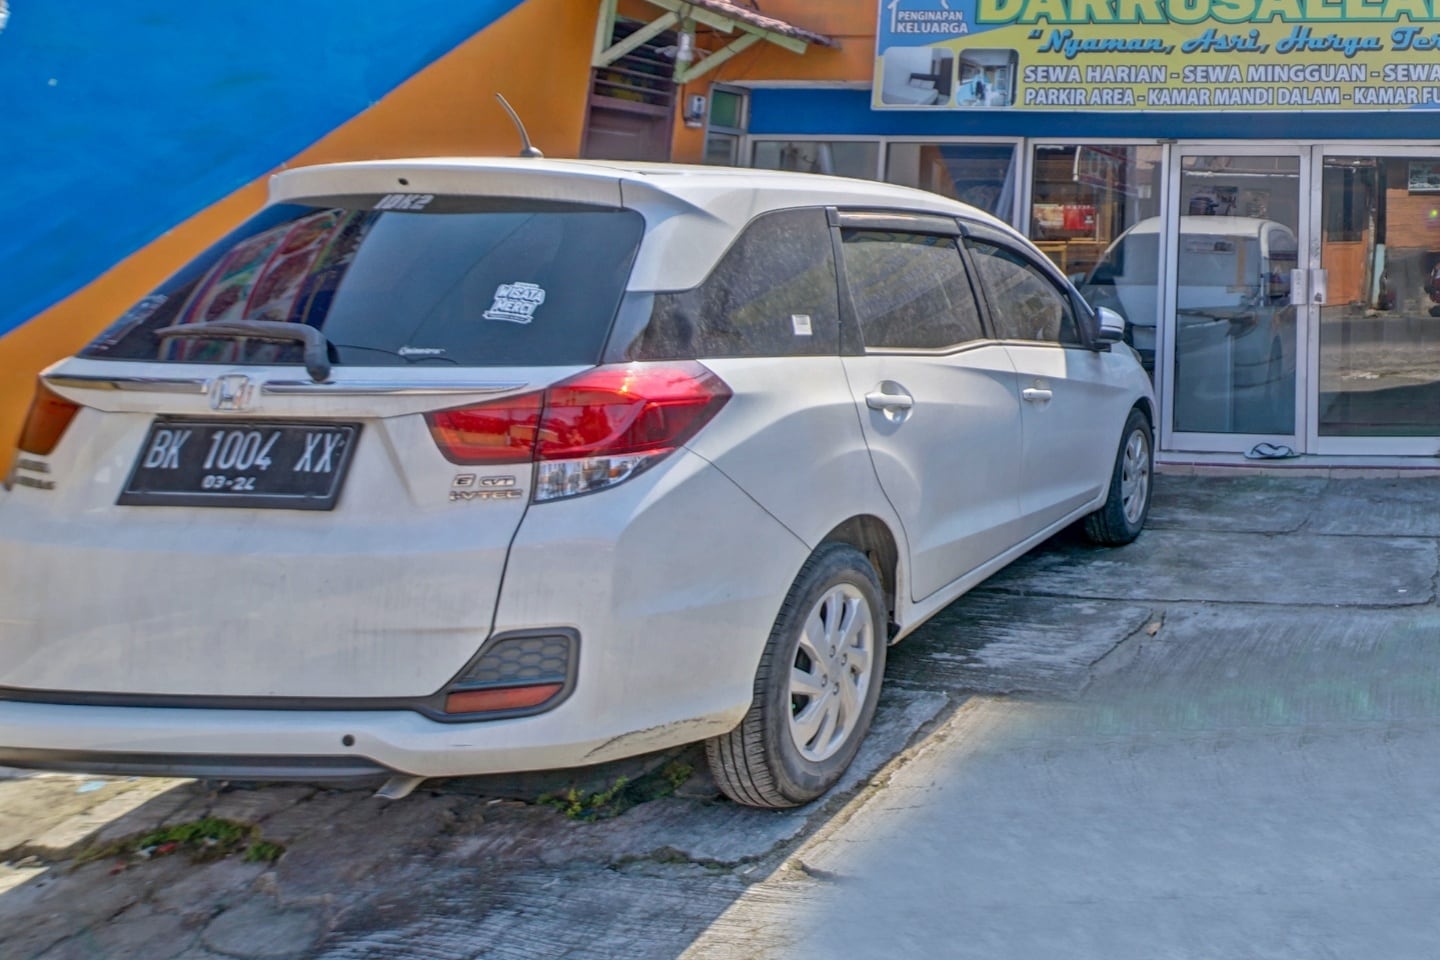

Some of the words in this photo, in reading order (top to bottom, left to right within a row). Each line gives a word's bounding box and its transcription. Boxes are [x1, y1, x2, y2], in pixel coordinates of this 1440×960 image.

[898, 10, 963, 21] PENGINAPAN
[896, 21, 968, 34] KELUARGA
[1181, 28, 1270, 54] Asri,
[1276, 25, 1384, 58] Harga
[1024, 65, 1082, 83] SEWA
[1086, 65, 1167, 83] HARIAN
[1182, 65, 1243, 83] SEWA
[1247, 64, 1367, 82] MINGGUAN
[1024, 87, 1087, 106] PARKIR
[1088, 87, 1136, 106] AREA
[1147, 88, 1212, 106] KAMAR
[1214, 87, 1275, 106] MANDI
[1276, 87, 1341, 105] DALAM
[1353, 86, 1419, 105] KAMAR
[495, 284, 545, 304] WISATA
[143, 430, 192, 469] BK
[203, 431, 280, 470] 1004
[293, 433, 342, 473] XX
